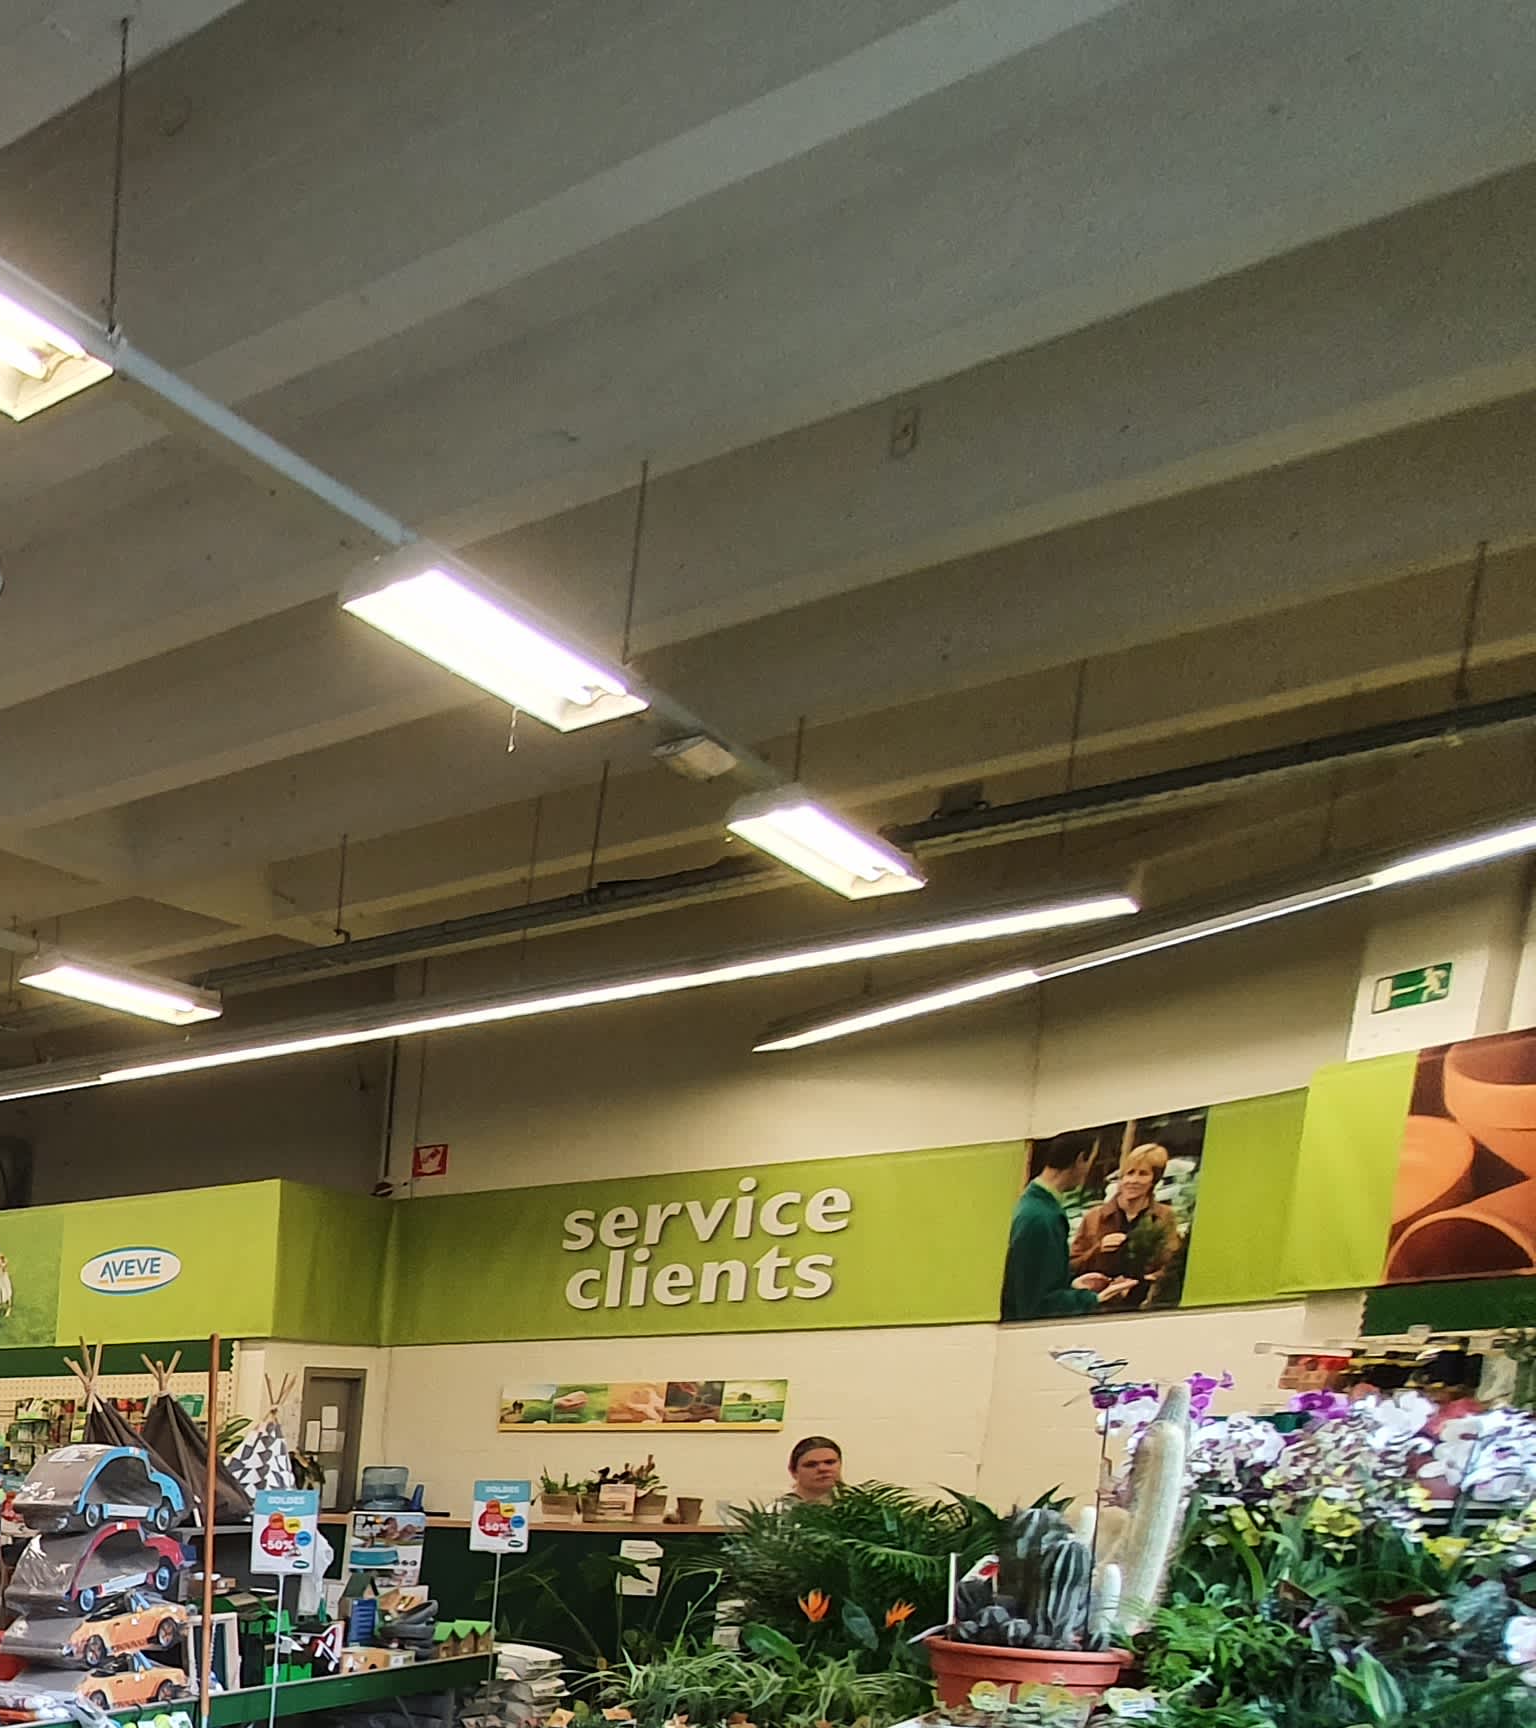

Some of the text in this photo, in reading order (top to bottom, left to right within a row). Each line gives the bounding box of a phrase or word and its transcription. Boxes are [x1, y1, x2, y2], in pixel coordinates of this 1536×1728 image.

[562, 1177, 852, 1251] service
[99, 1256, 161, 1279] AVEVE
[565, 1245, 834, 1310] clients
[262, 1540, 294, 1551] -50%
